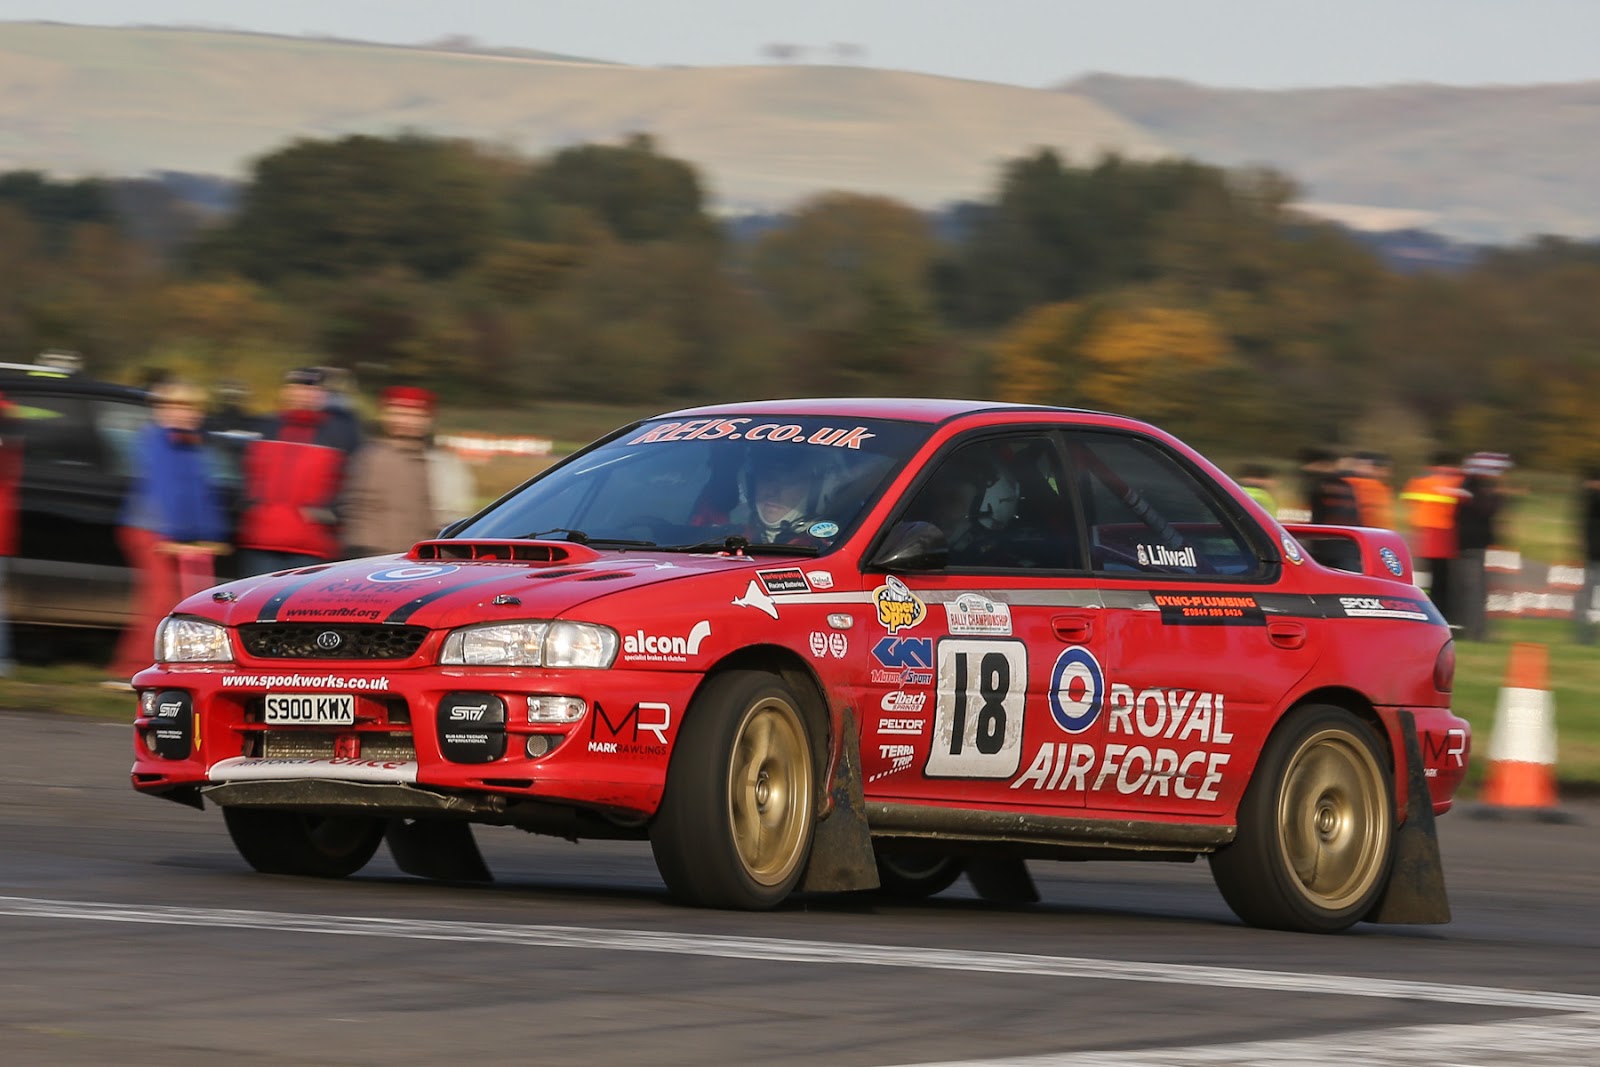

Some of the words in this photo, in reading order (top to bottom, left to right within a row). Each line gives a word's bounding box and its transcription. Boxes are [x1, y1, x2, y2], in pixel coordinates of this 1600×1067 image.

[627, 418, 875, 449] REIS.co.uk
[1147, 545, 1197, 567] Lilwall
[318, 583, 421, 592] RAFBF
[1155, 596, 1256, 607] DYNO-PLUMBING
[286, 608, 381, 620] www.rafbf.org
[951, 613, 967, 626] RALLY
[968, 613, 1008, 626] CHAMPIONSHIP
[624, 630, 687, 655] alcon
[222, 674, 389, 689] www.spookworks.co.uk
[267, 698, 313, 720] S900
[317, 698, 351, 720] KWX
[949, 652, 1010, 755] 18
[590, 701, 671, 744] MR
[1109, 683, 1233, 744] ROYAL
[879, 719, 923, 729] PELTOR
[879, 745, 914, 758] TERRA
[892, 755, 913, 768] TRIP
[1010, 742, 1095, 791] AIR
[1092, 744, 1231, 801] FORCE
